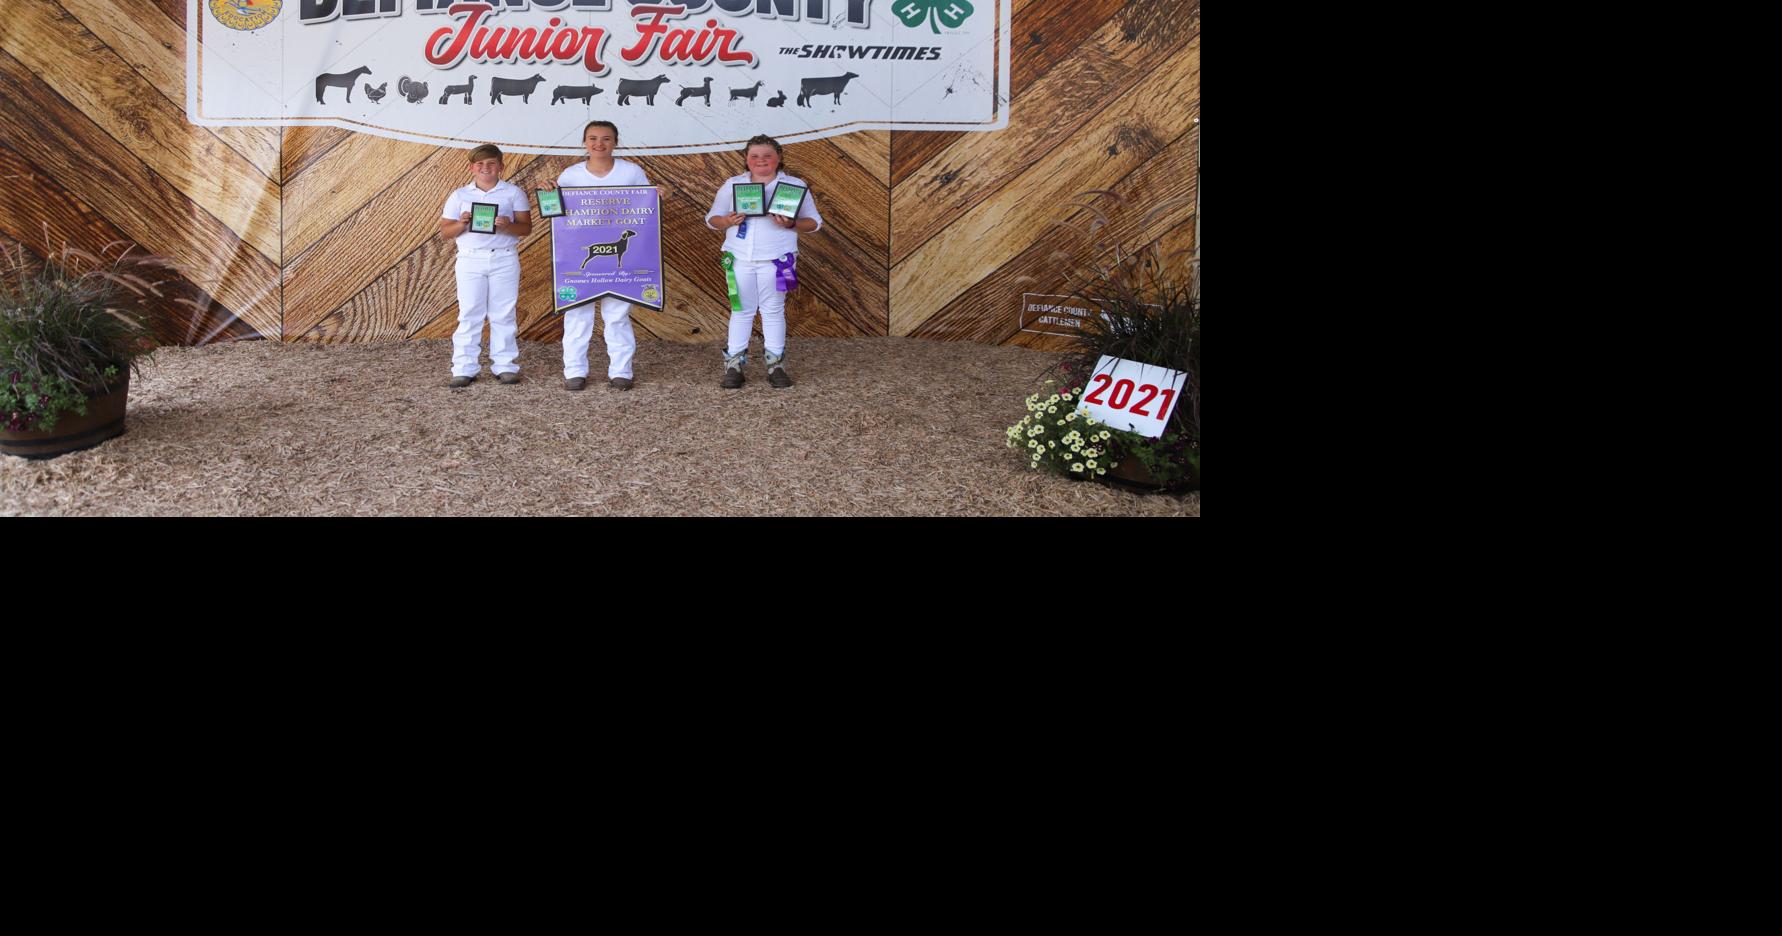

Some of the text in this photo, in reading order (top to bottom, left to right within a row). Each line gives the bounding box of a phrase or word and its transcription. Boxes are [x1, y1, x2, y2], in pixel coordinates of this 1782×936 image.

[425, 3, 607, 73] Junior
[620, 4, 754, 65] Fair
[778, 47, 800, 55] THE
[581, 198, 632, 206] RESERVE
[565, 207, 655, 217] HAMPION DAIRY
[566, 217, 646, 226] MARKET GOAT
[592, 245, 618, 254] 2021
[1027, 303, 1063, 314] DEFIANCE
[1038, 315, 1081, 328] CATTLEMEN
[1084, 373, 1176, 421] 2021
